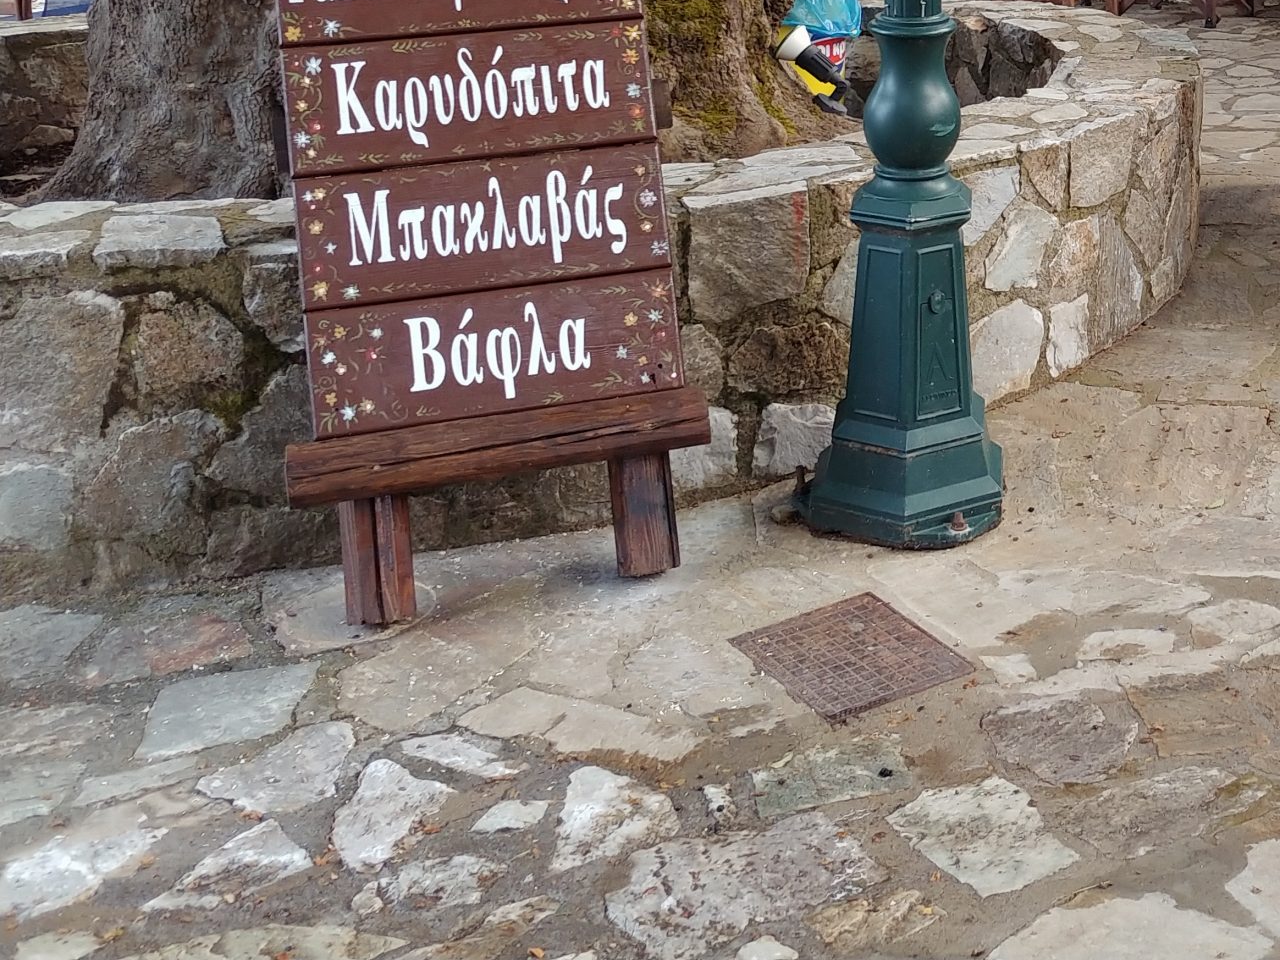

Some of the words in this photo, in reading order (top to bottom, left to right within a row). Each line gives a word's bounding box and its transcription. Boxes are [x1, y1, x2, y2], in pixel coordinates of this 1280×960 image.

[330, 45, 611, 148] Καρυδόπιτα
[343, 164, 628, 266] Μπακλαβάς
[403, 301, 591, 400] Βάφλα
